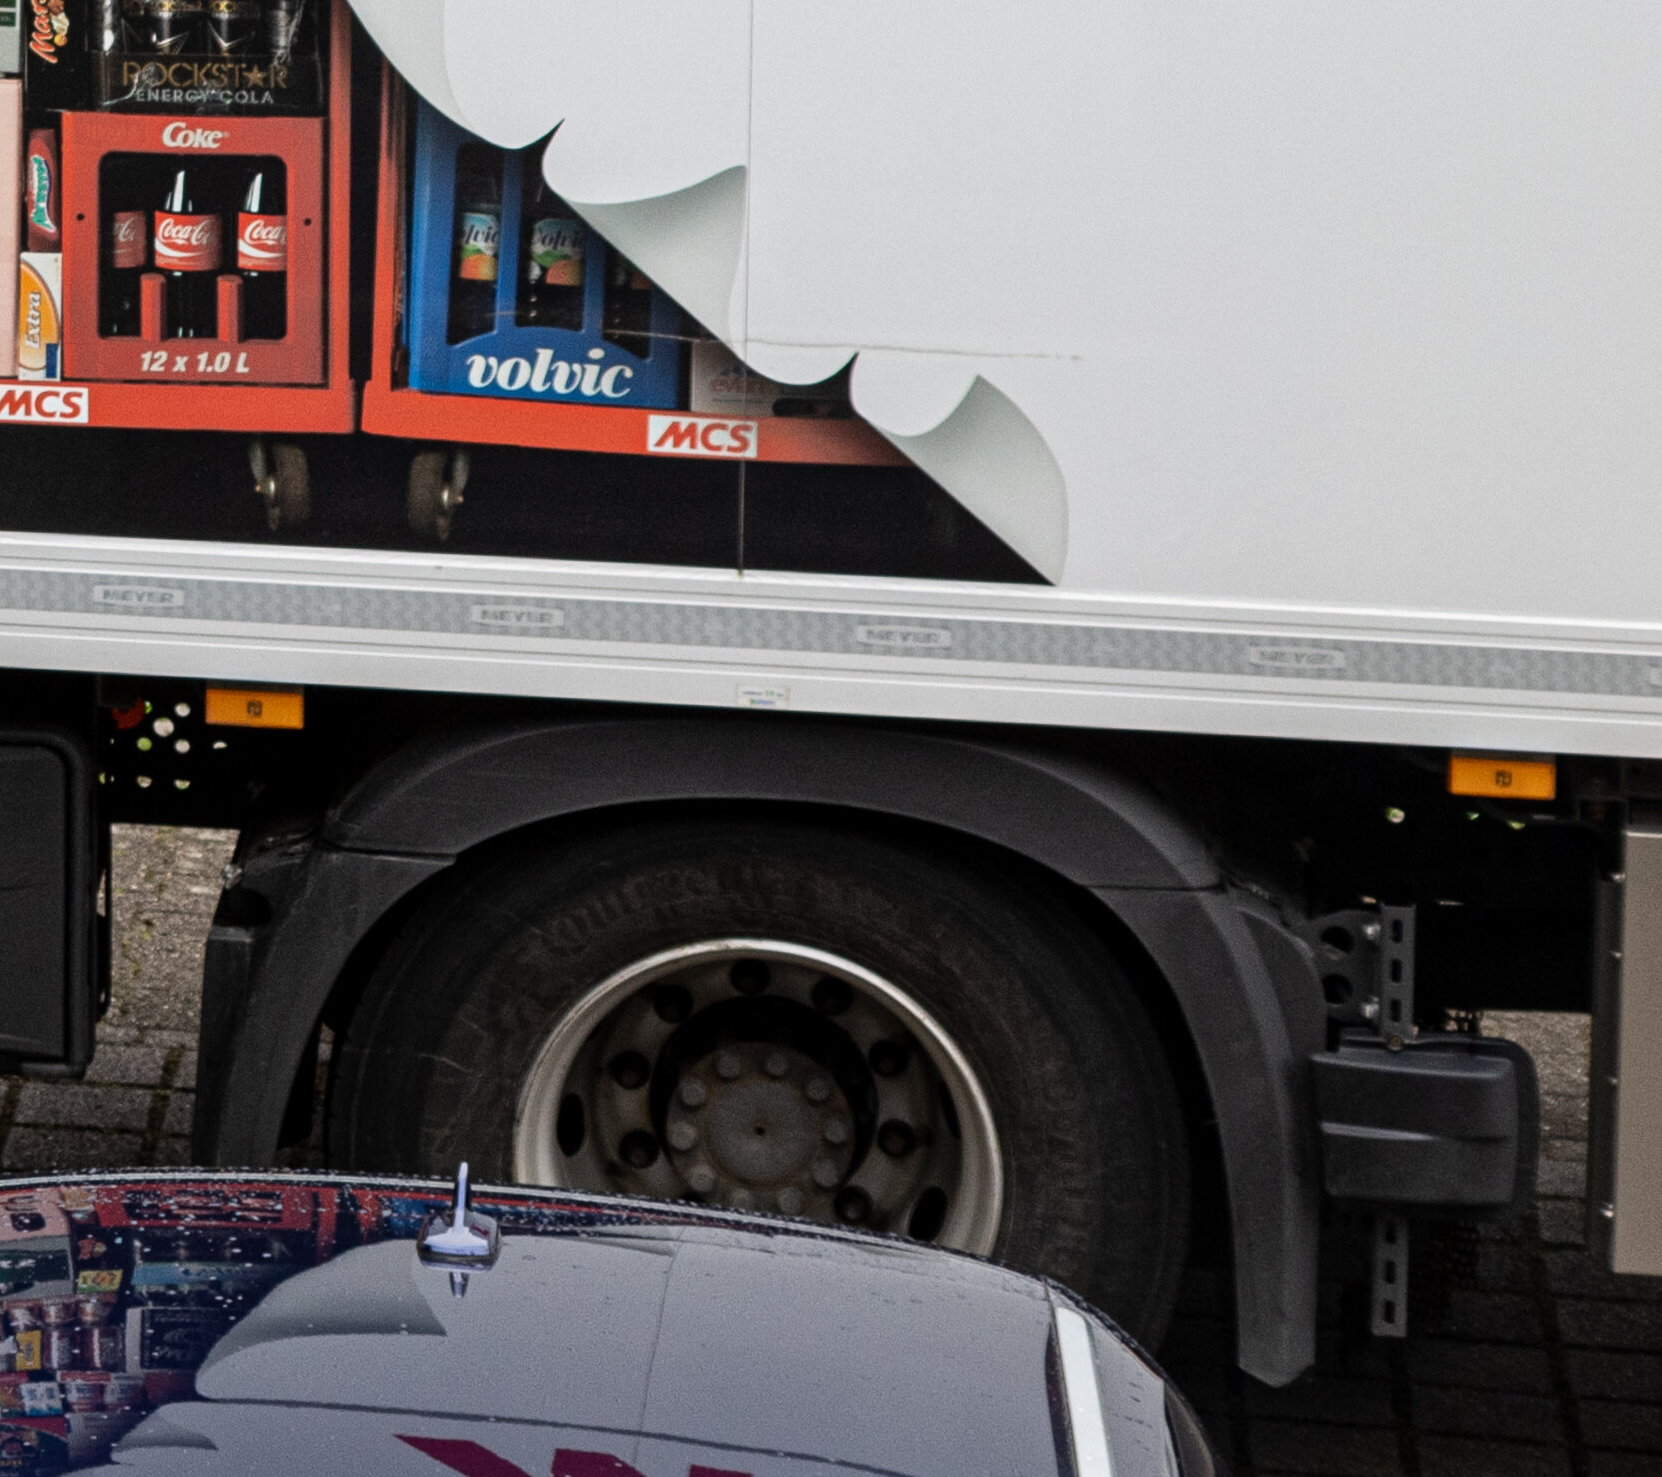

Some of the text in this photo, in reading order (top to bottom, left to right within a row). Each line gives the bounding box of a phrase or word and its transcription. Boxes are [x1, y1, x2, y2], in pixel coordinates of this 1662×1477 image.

[135, 88, 274, 105] ENERGY COLA
[162, 121, 222, 148] Coke
[24, 290, 41, 350] Extra
[140, 351, 250, 374] 12 x 1.0 L
[466, 346, 634, 400] volvic
[653, 420, 755, 455] MCS
